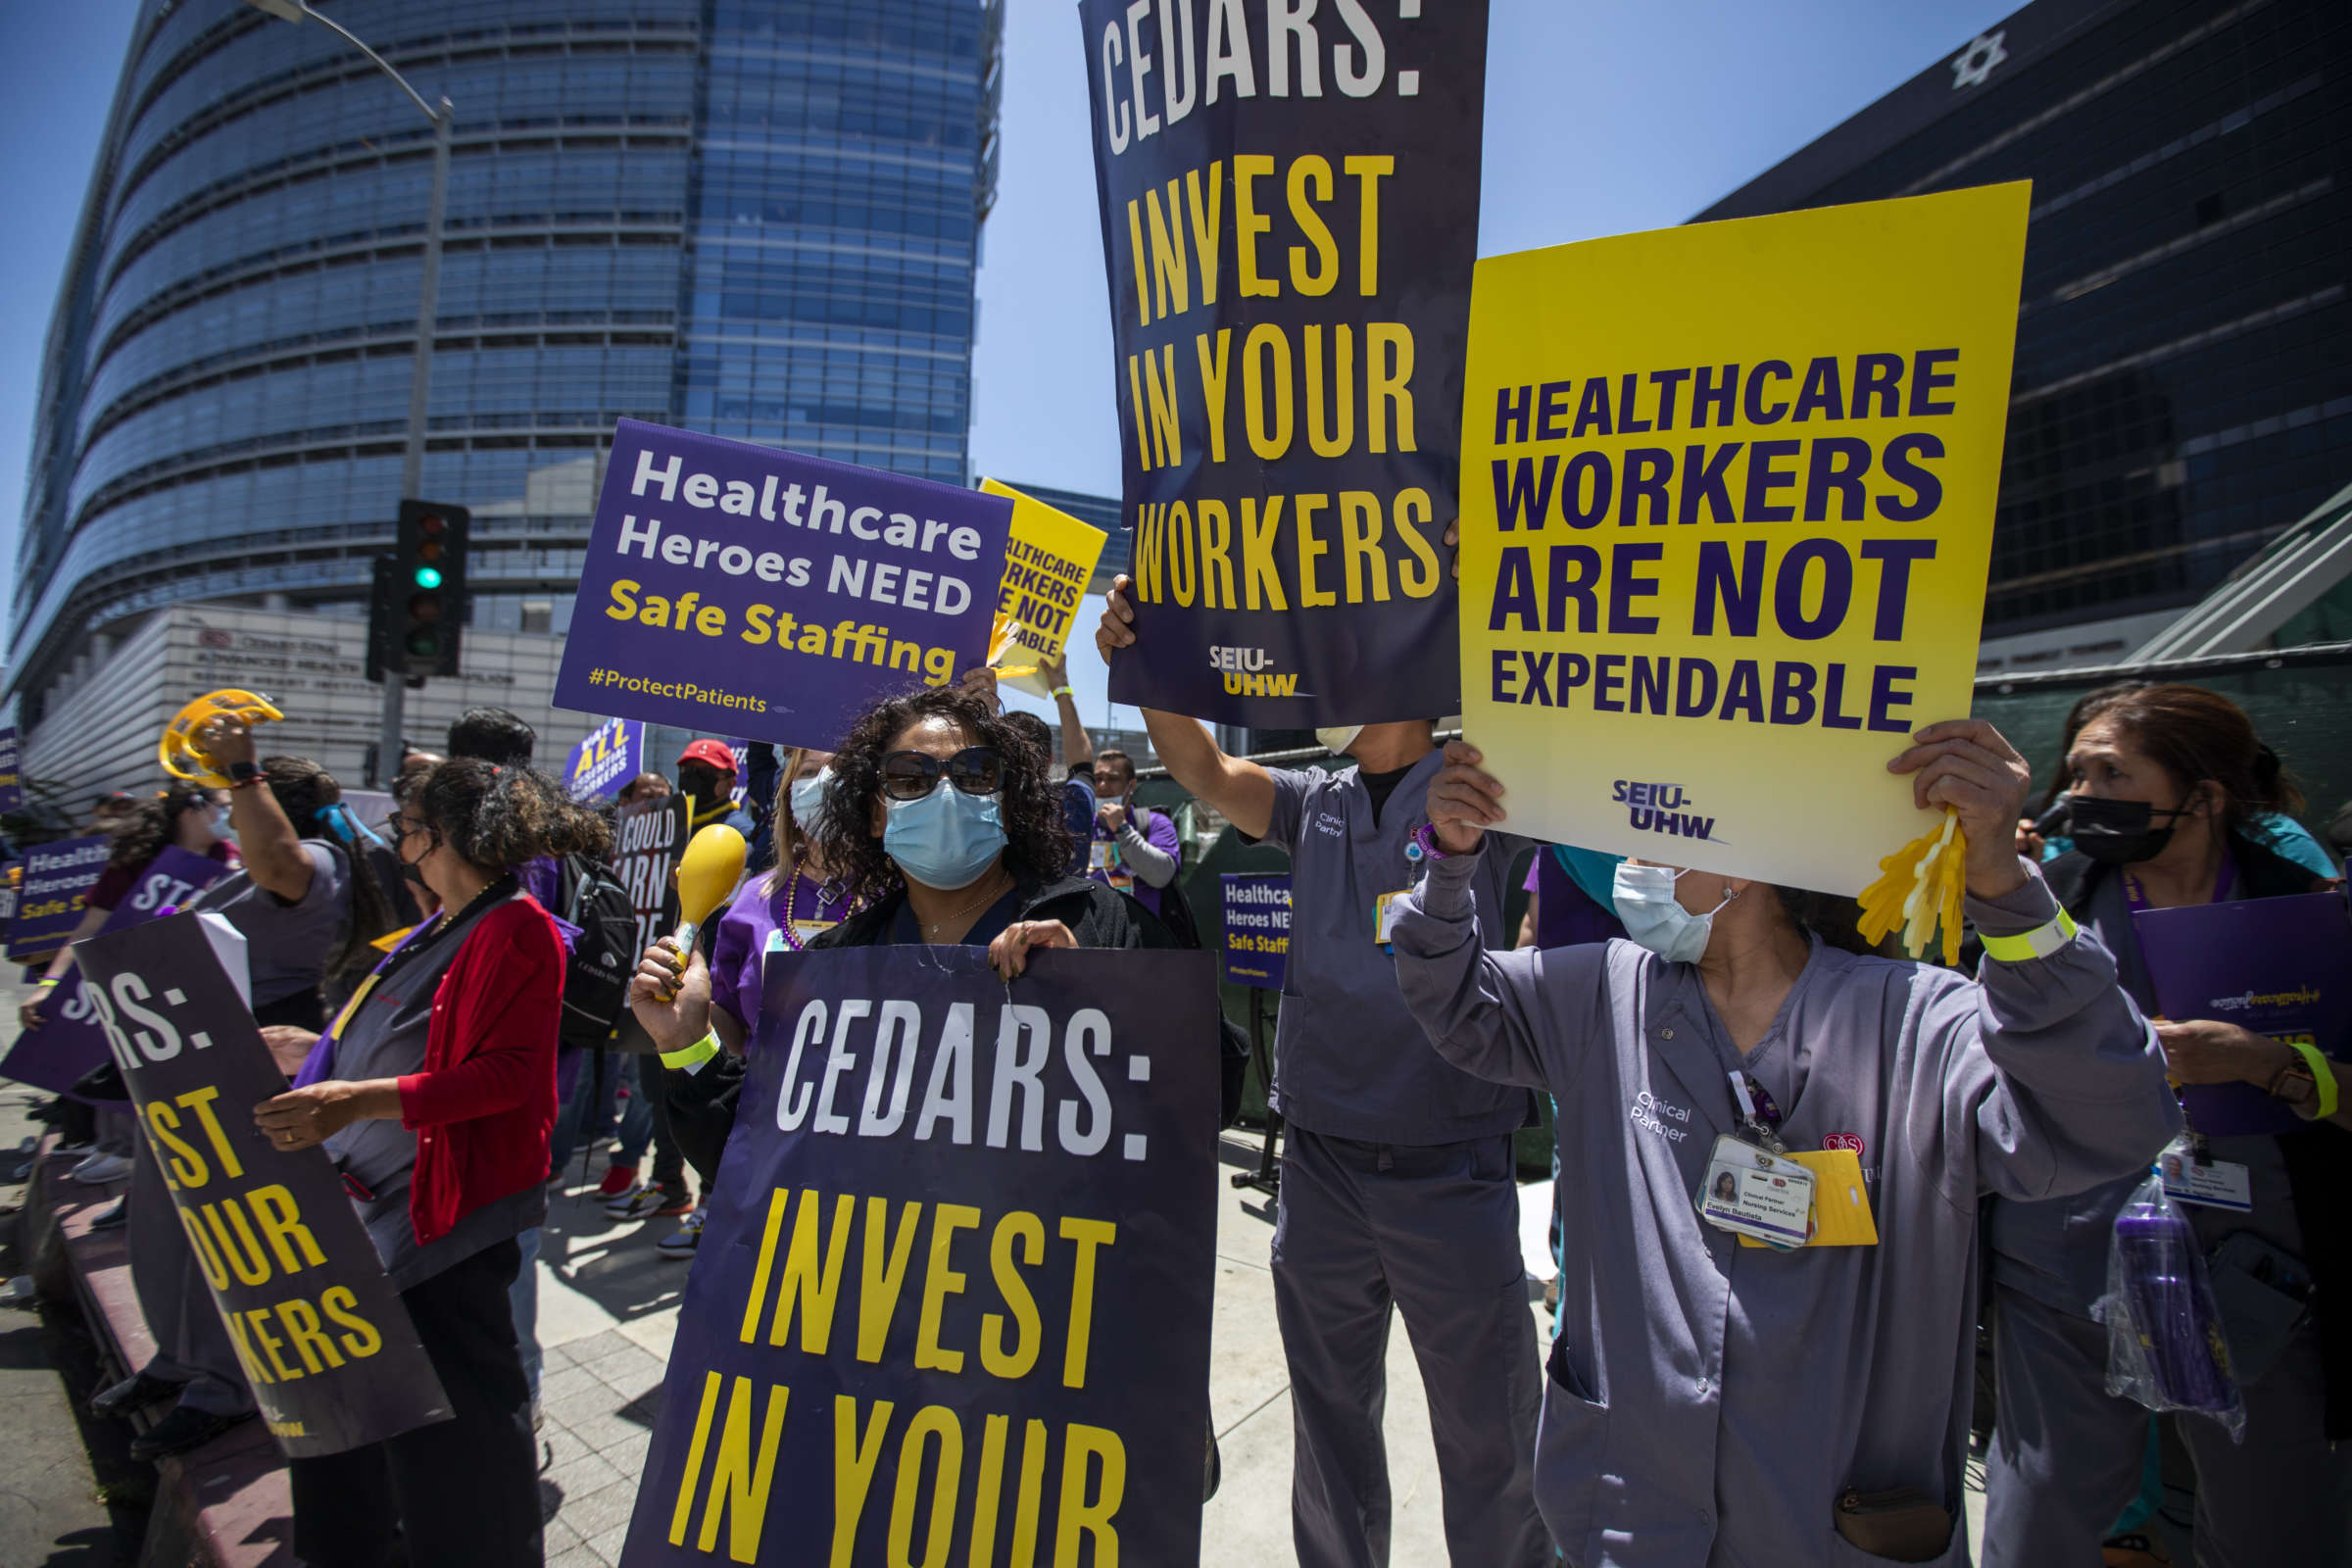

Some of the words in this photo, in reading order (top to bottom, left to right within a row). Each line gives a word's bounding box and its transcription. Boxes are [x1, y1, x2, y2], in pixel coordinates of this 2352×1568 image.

[1102, 0, 1421, 156] CEDARS:
[1128, 154, 1395, 327] INVEST
[1128, 343, 1182, 471] IN
[1197, 321, 1418, 464] YOUR
[1494, 348, 1961, 445] HEALTHCARE
[630, 450, 981, 561] Healthcare
[1491, 432, 1946, 532] WORKERS
[616, 514, 811, 588] Heroes
[827, 554, 972, 616] NEED
[1005, 537, 1087, 585] ALTHCARE
[1134, 487, 1441, 611] WORKERS
[1003, 558, 1078, 609] RKERS
[1488, 541, 1664, 637] ARE
[1691, 538, 1936, 642] NOT
[605, 578, 727, 637] Safe
[741, 603, 956, 688] Staffing
[1015, 595, 1070, 636] NOT
[1015, 628, 1059, 658] ABLE
[1209, 645, 1274, 671] SEIU-
[588, 666, 767, 714] #ProtectPatients
[1225, 672, 1298, 697] UHW
[1491, 649, 1918, 734] EXPENDABLE
[574, 722, 629, 780] ALL
[1612, 779, 1691, 809] SEIU-
[622, 808, 676, 855] COULD
[1315, 820, 1343, 837] Partn
[1319, 812, 1345, 827] Clinic
[1631, 808, 1715, 841] UHW
[28, 844, 112, 874] Health
[21, 899, 68, 920] Safe
[1225, 884, 1292, 906] Healthca
[1227, 909, 1269, 927] Heroes
[1272, 911, 1292, 929] NE
[1229, 933, 1254, 951] Safe
[1256, 935, 1289, 955] Staff
[777, 999, 1151, 1161] CEDARS:
[1631, 1106, 1688, 1143] Partner
[1638, 1091, 1690, 1123] Clinical
[1706, 1201, 1731, 1213] Evelyn
[1733, 1206, 1762, 1221] Bautista
[1742, 1200, 1767, 1212] Nursing
[1769, 1205, 1795, 1217] Services
[178, 1183, 327, 1292] OUR
[740, 1187, 1116, 1389] INVEST
[222, 1285, 382, 1386] KERS
[668, 1370, 789, 1565] IN
[829, 1393, 1126, 1568] YOUR
